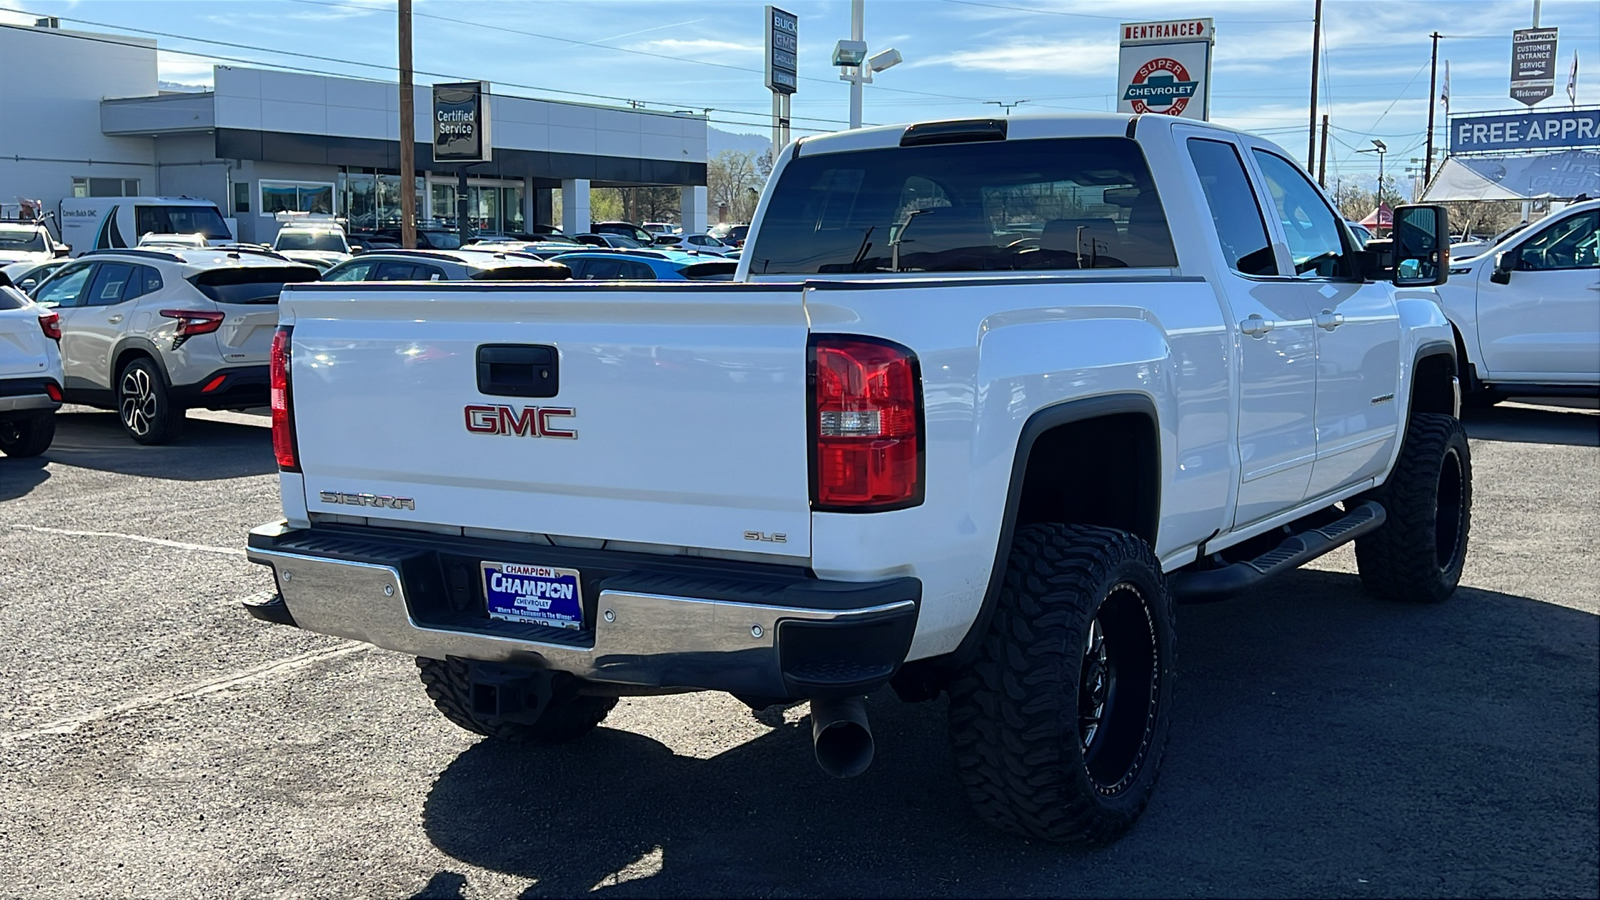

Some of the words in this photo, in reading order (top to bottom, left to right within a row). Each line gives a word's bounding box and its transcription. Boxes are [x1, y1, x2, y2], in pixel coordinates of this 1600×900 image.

[774, 16, 797, 32] BUICK
[1133, 22, 1195, 39] ENTRANCE
[1515, 33, 1557, 42] CHAMPION
[1516, 44, 1552, 53] CUSTOMER
[1516, 52, 1551, 61] ENTRANCE
[1140, 59, 1183, 77] SUPER
[1519, 61, 1547, 69] SERVICE
[1128, 85, 1193, 96] CHEVROLET
[1515, 88, 1548, 98] Welcome!
[437, 110, 474, 122] Certified
[440, 122, 472, 134] Service
[1458, 121, 1520, 145] FREE
[464, 403, 578, 440] GMC
[319, 490, 415, 511] SIERRA
[743, 530, 787, 544] SLE
[505, 565, 551, 577] CHAMPION
[491, 572, 574, 600] CHAMPION
[515, 597, 550, 608] CHEVROLET
